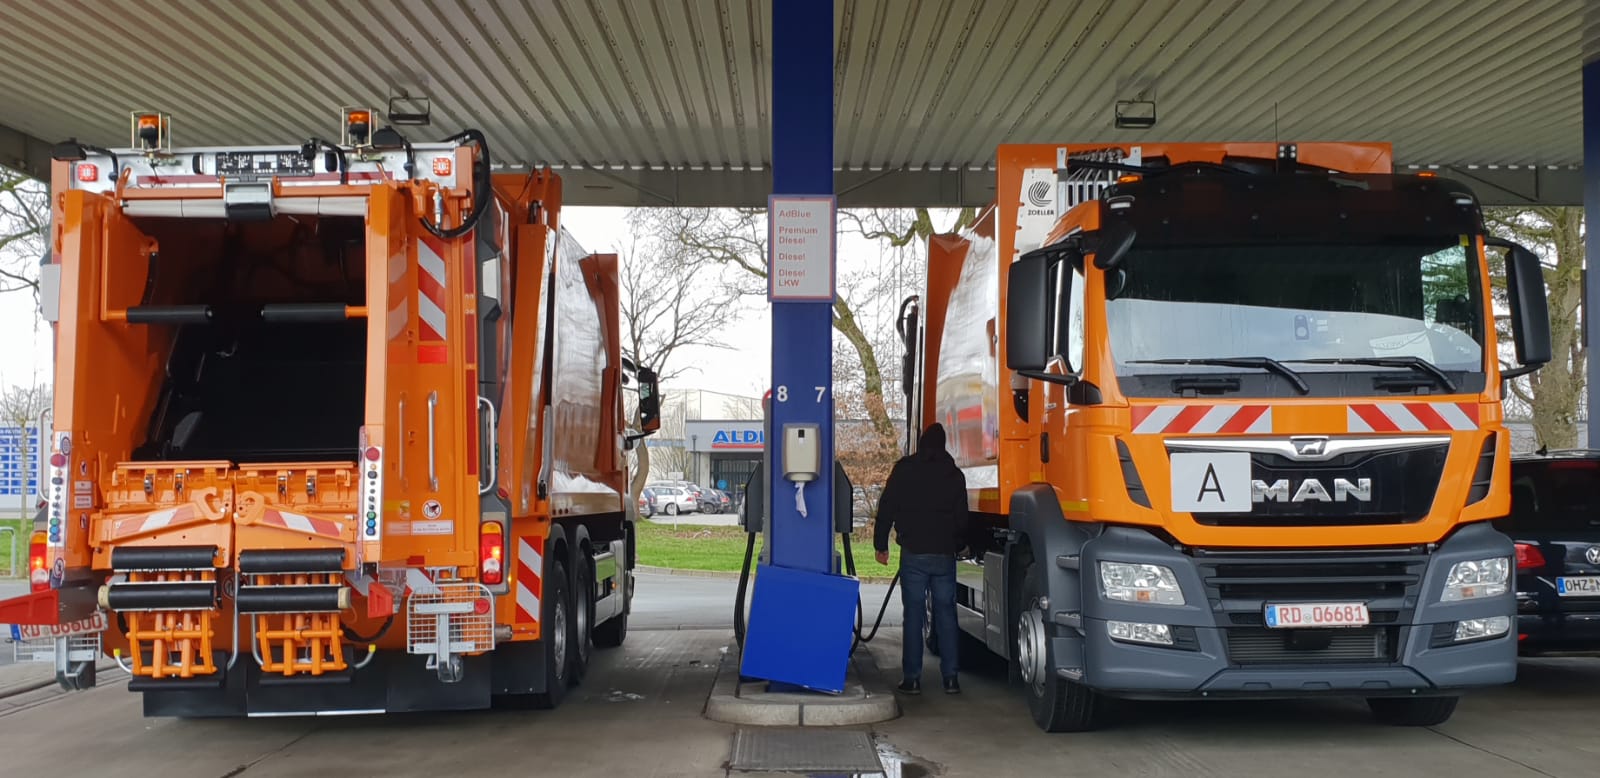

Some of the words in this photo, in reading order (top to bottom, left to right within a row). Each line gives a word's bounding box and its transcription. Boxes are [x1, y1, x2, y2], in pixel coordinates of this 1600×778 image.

[779, 209, 811, 218] AdBlue
[779, 226, 818, 234] Premium
[779, 253, 806, 261] Diesel
[779, 269, 806, 277] Diesel
[777, 385, 788, 402] 8
[815, 386, 826, 403] 7
[1197, 462, 1226, 502] A
[1252, 478, 1371, 502] MAN
[1280, 607, 1302, 623] RD
[1313, 605, 1365, 622] 06681
